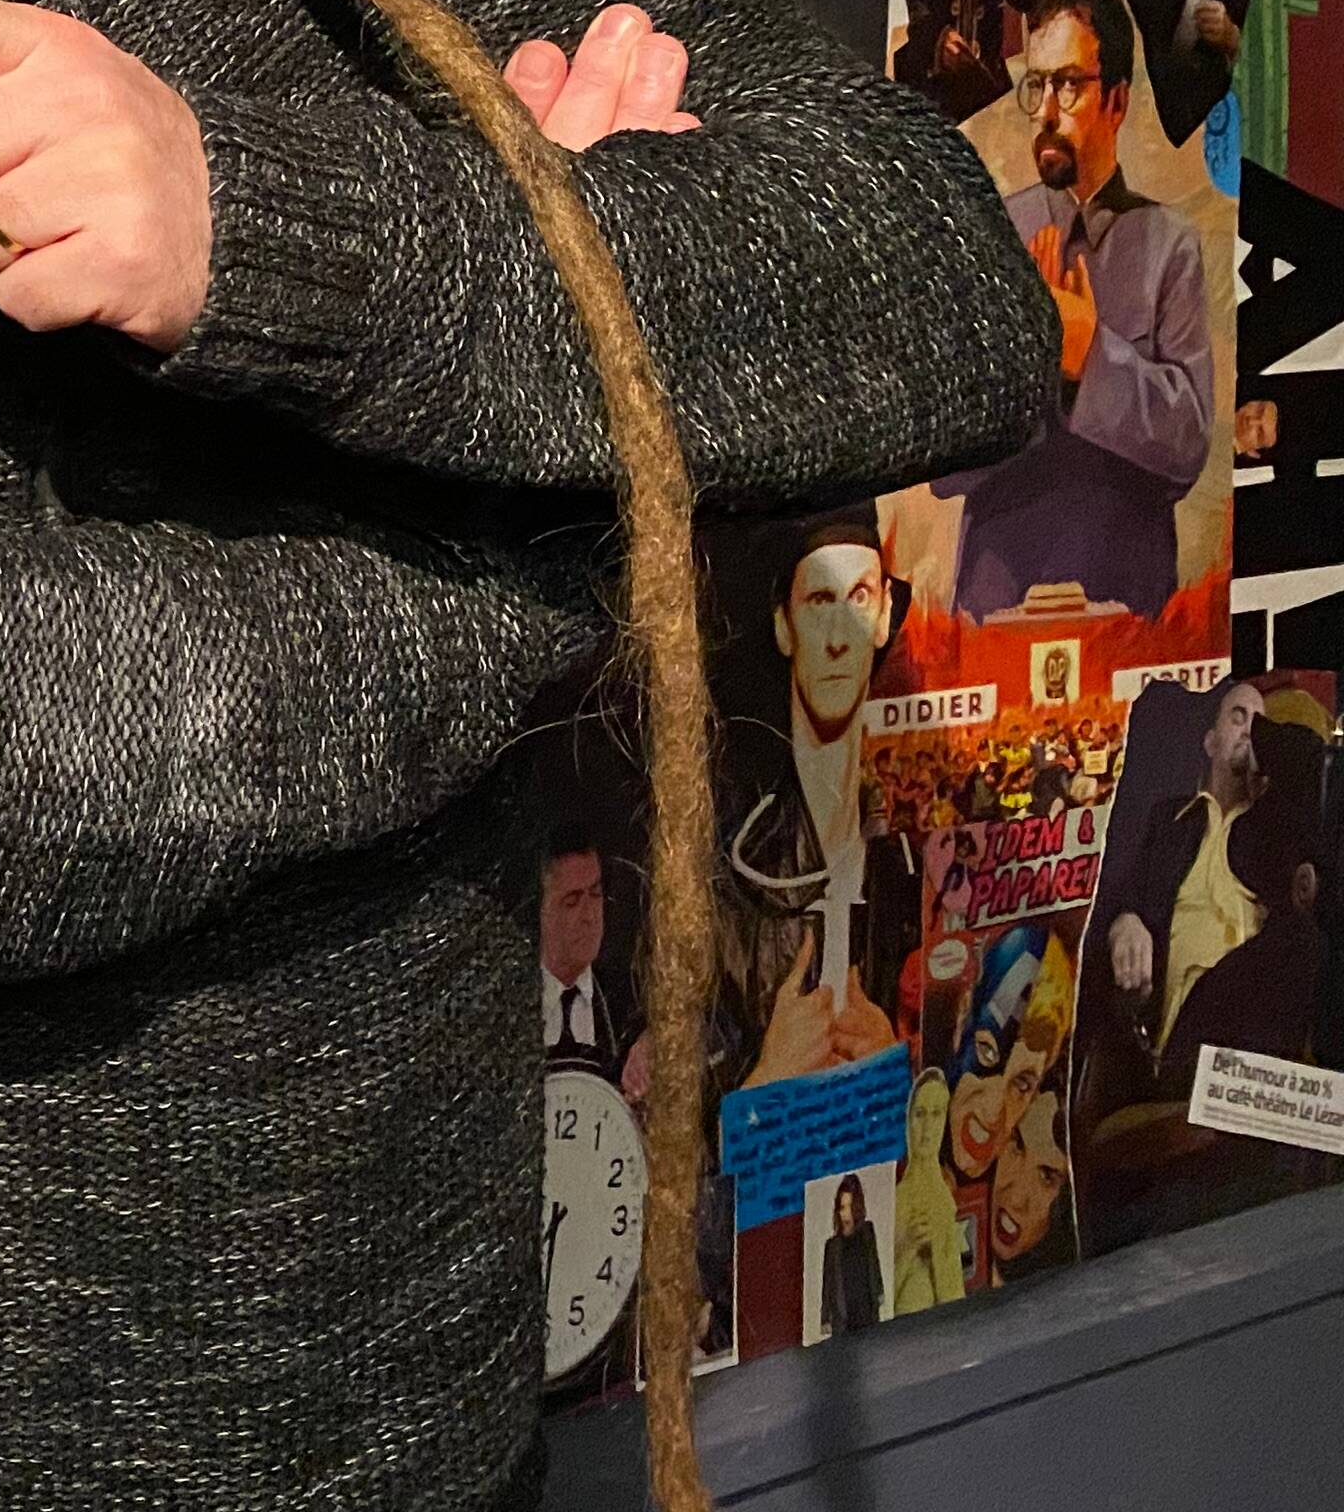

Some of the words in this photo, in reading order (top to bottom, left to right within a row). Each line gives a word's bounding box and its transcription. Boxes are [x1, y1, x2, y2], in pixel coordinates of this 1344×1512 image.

[883, 691, 983, 729] DIDIER
[980, 809, 1069, 874] IDEM
[1207, 1083, 1225, 1100] au
[1299, 1099, 1313, 1121] Le
[1298, 1075, 1321, 1097] 200
[554, 1109, 578, 1141] 12
[593, 1121, 602, 1151] 1
[607, 1157, 624, 1189] 2
[610, 1204, 628, 1237] 3
[596, 1255, 613, 1286] 4
[567, 1294, 585, 1327] 5
